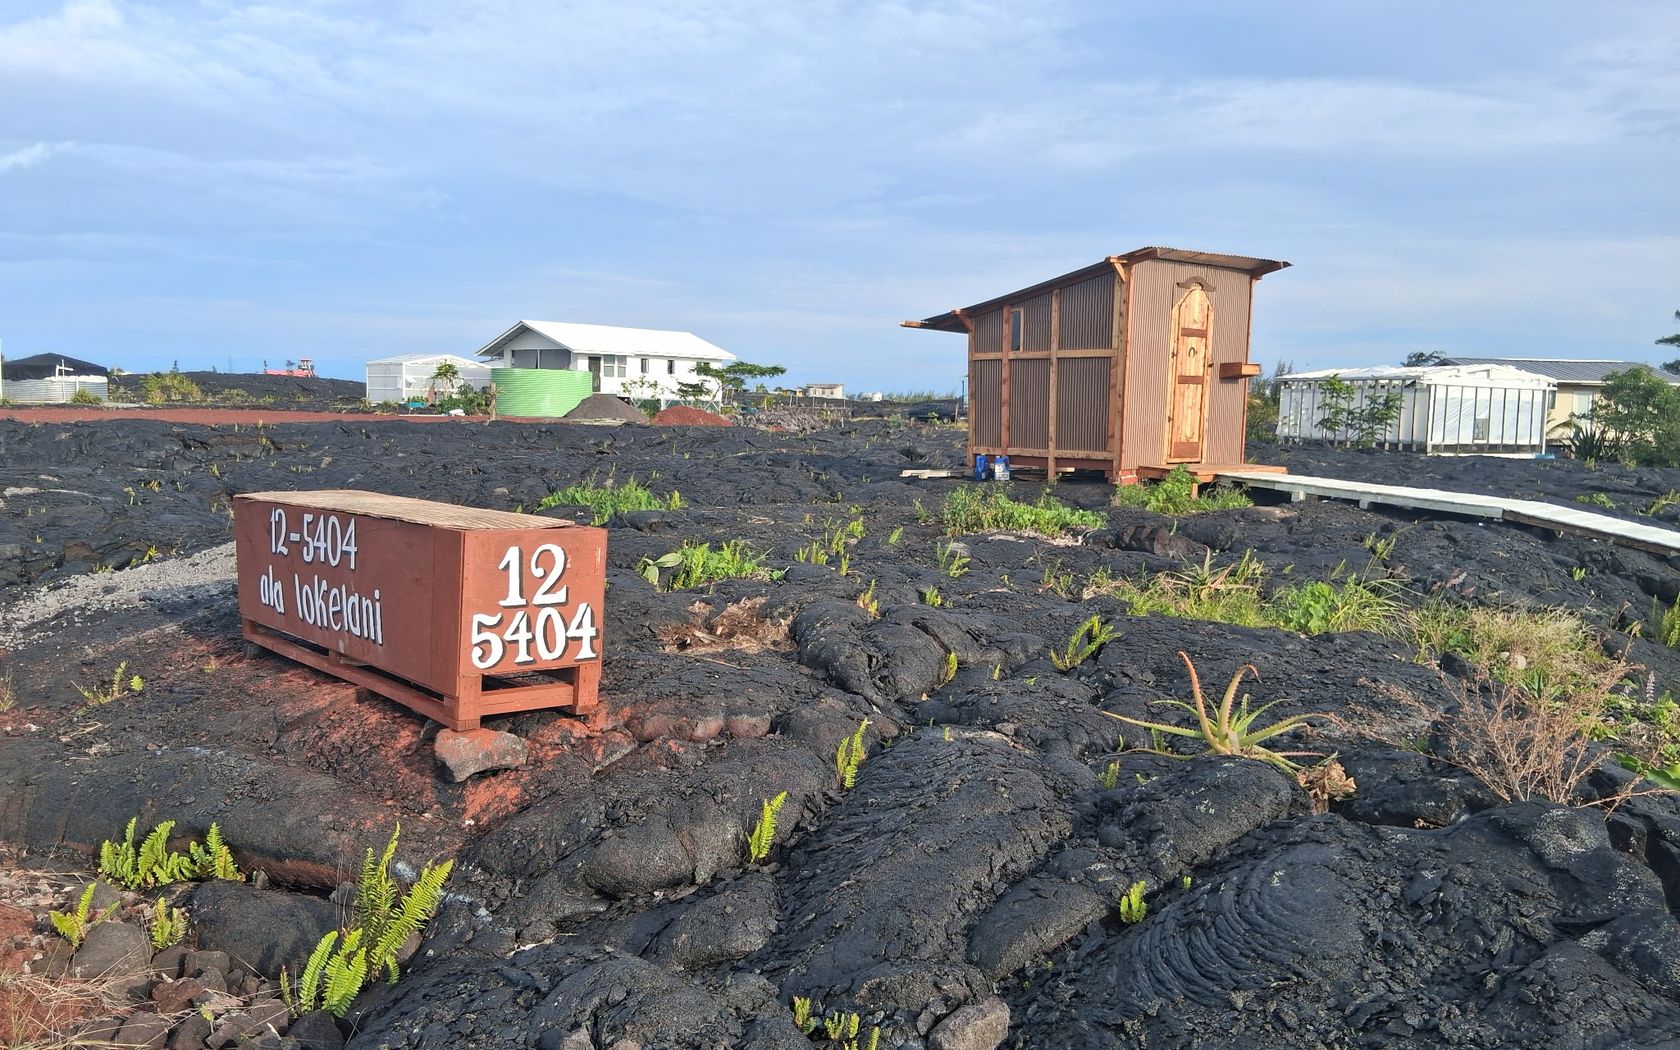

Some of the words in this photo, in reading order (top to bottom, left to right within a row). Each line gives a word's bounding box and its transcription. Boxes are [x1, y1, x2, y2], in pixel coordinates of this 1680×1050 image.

[270, 507, 358, 570] 12-5404
[260, 564, 285, 614] ala
[498, 543, 567, 607] 12
[471, 602, 597, 669] 5404
